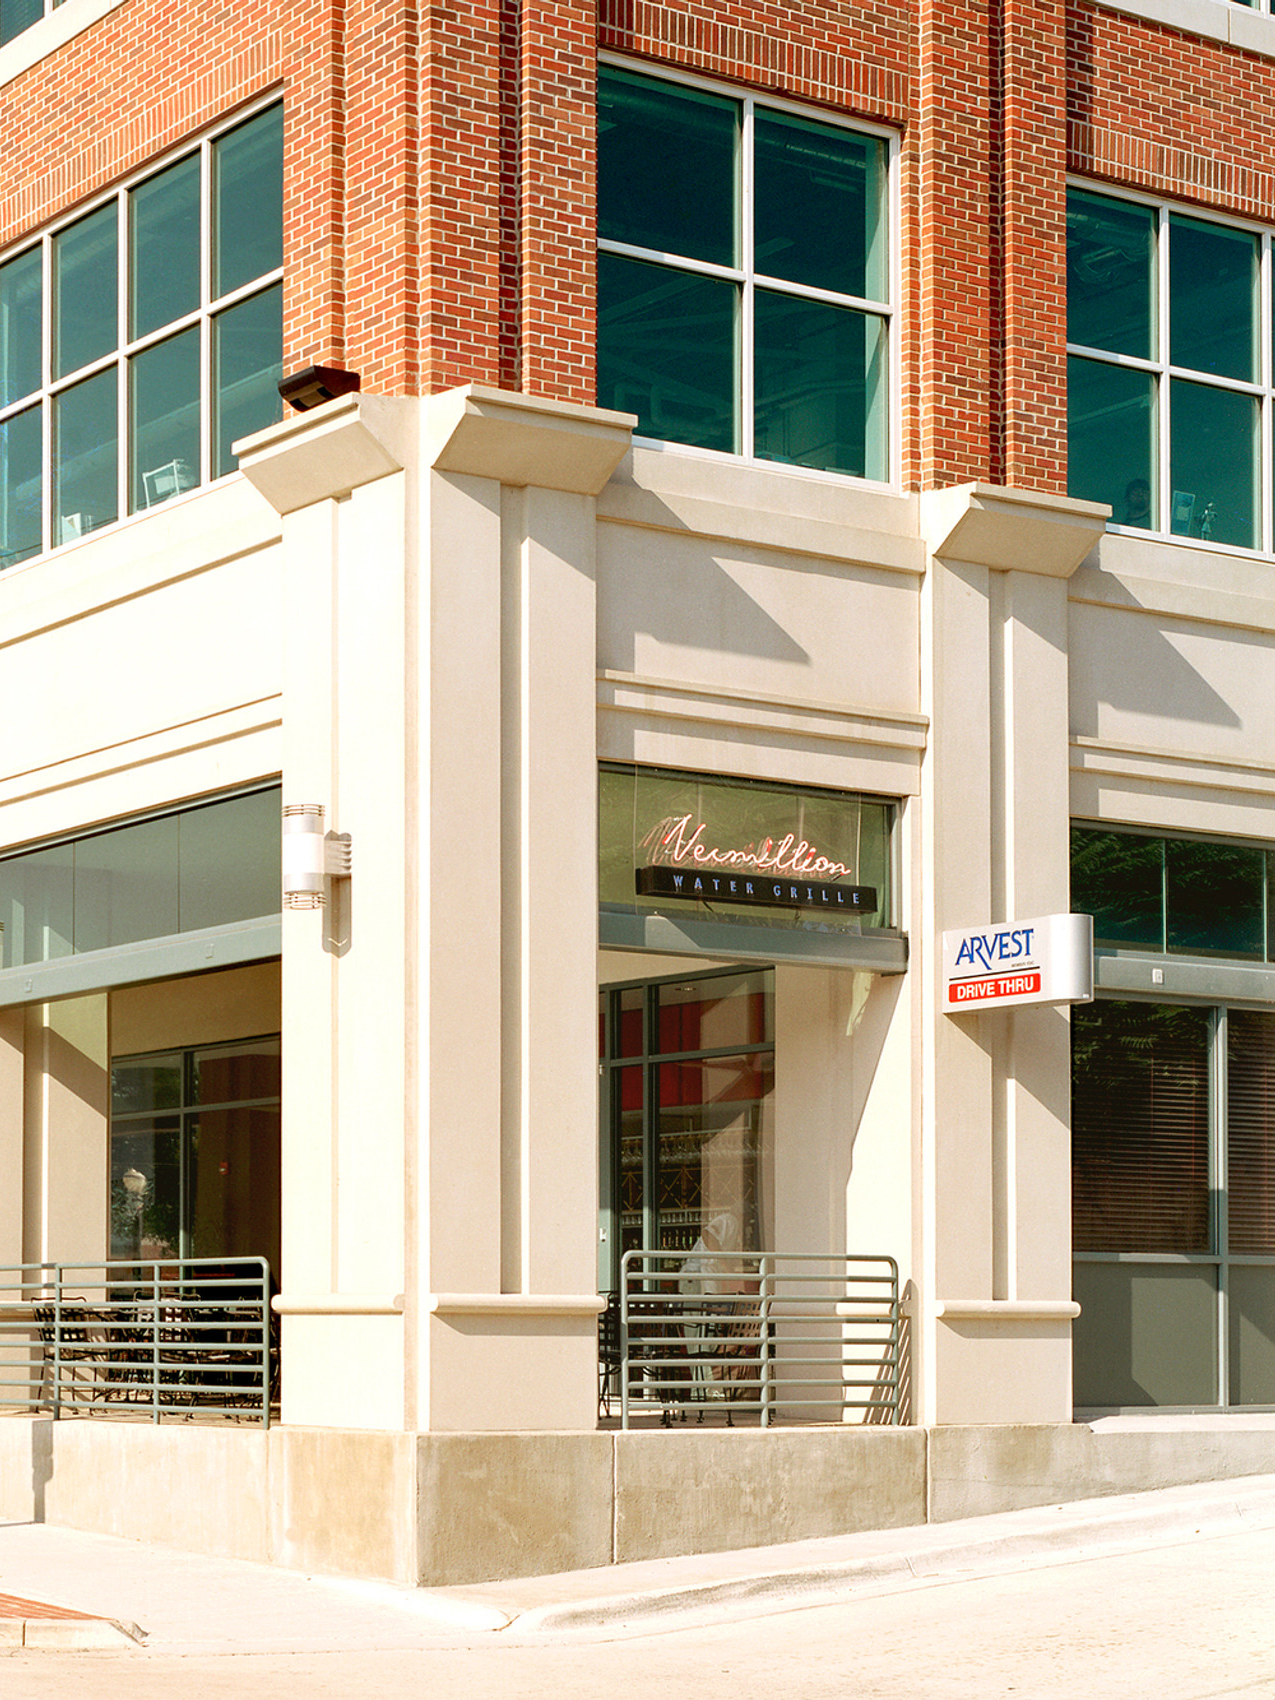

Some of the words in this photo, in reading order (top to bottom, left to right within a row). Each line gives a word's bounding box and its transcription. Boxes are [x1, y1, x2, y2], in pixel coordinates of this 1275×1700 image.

[673, 874, 754, 895] WATER
[773, 884, 860, 905] GRILLE
[954, 928, 1034, 971] ARVEST
[957, 981, 995, 1000] DRIVE
[997, 976, 1034, 994] THRU
